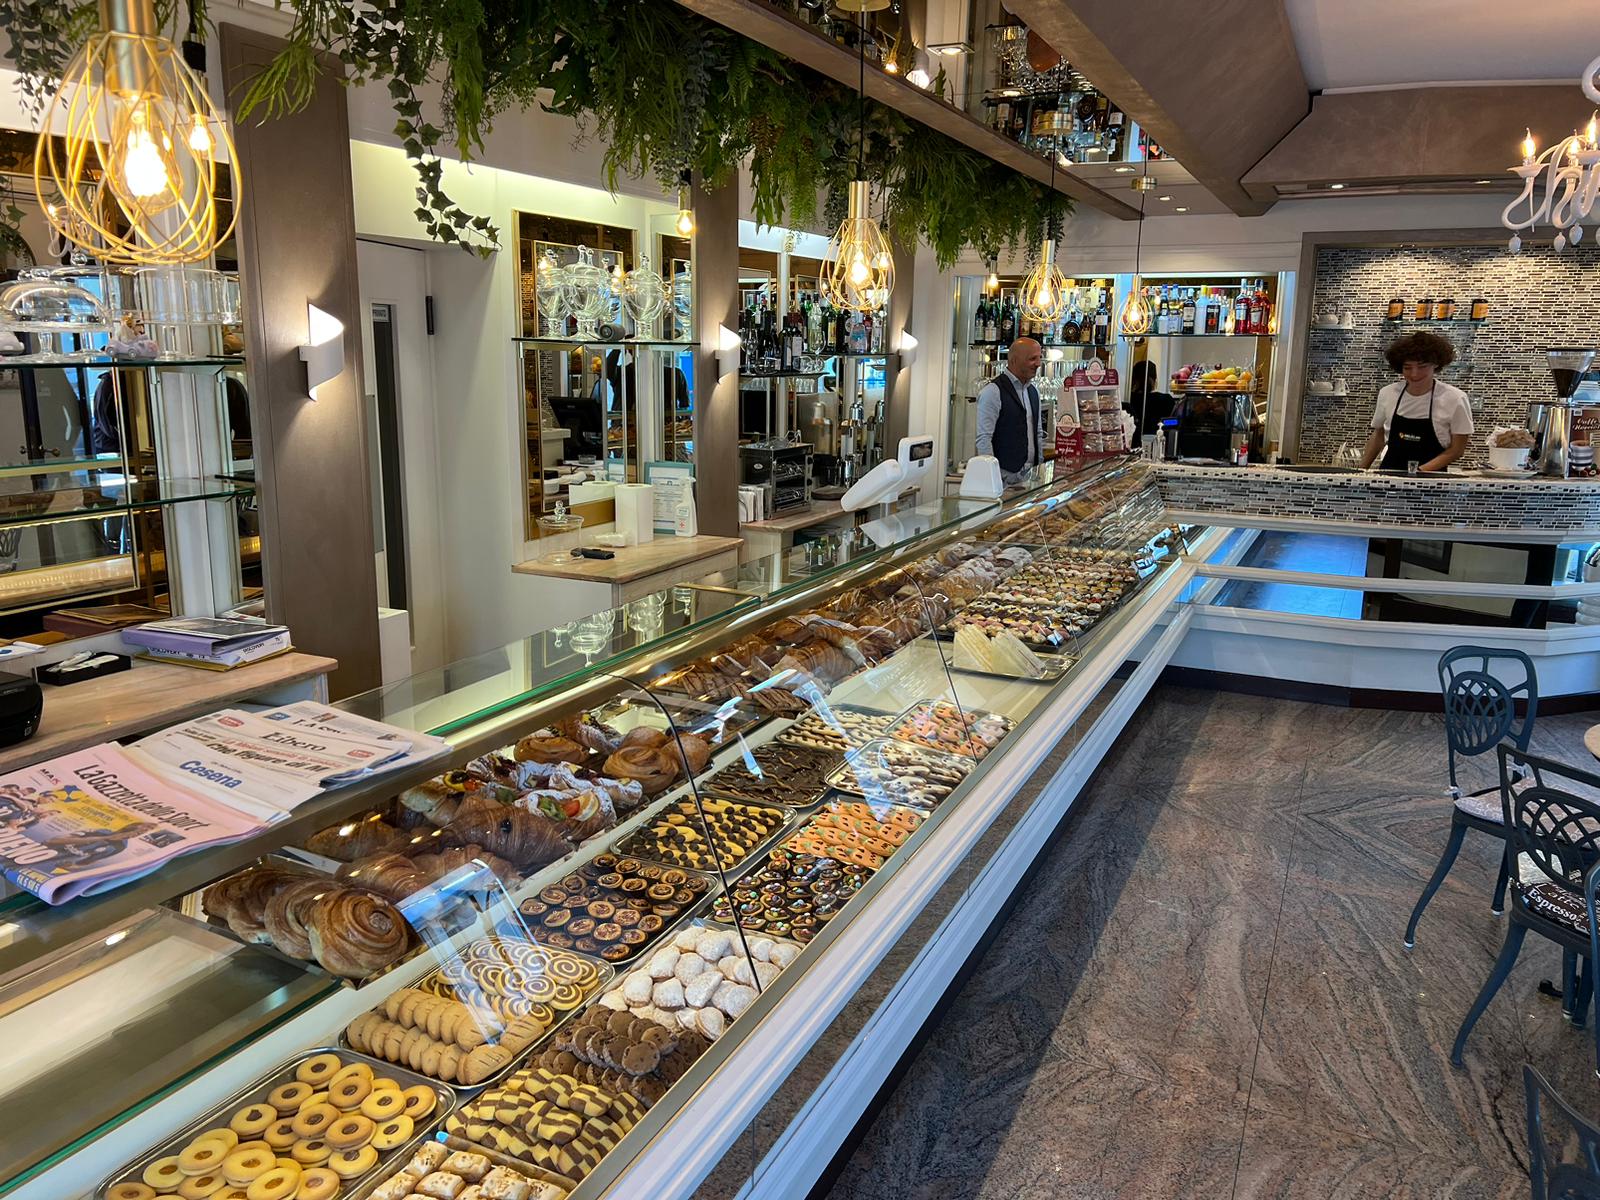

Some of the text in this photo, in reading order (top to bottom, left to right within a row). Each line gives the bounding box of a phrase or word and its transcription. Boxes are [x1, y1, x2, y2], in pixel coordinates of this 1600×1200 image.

[261, 732, 327, 751] Libero
[73, 764, 105, 780] La
[179, 760, 243, 789] Cesena
[87, 774, 149, 811] Gazzetta
[142, 799, 176, 818] dello
[158, 811, 211, 832] Sport
[1528, 888, 1577, 920] Espresso
